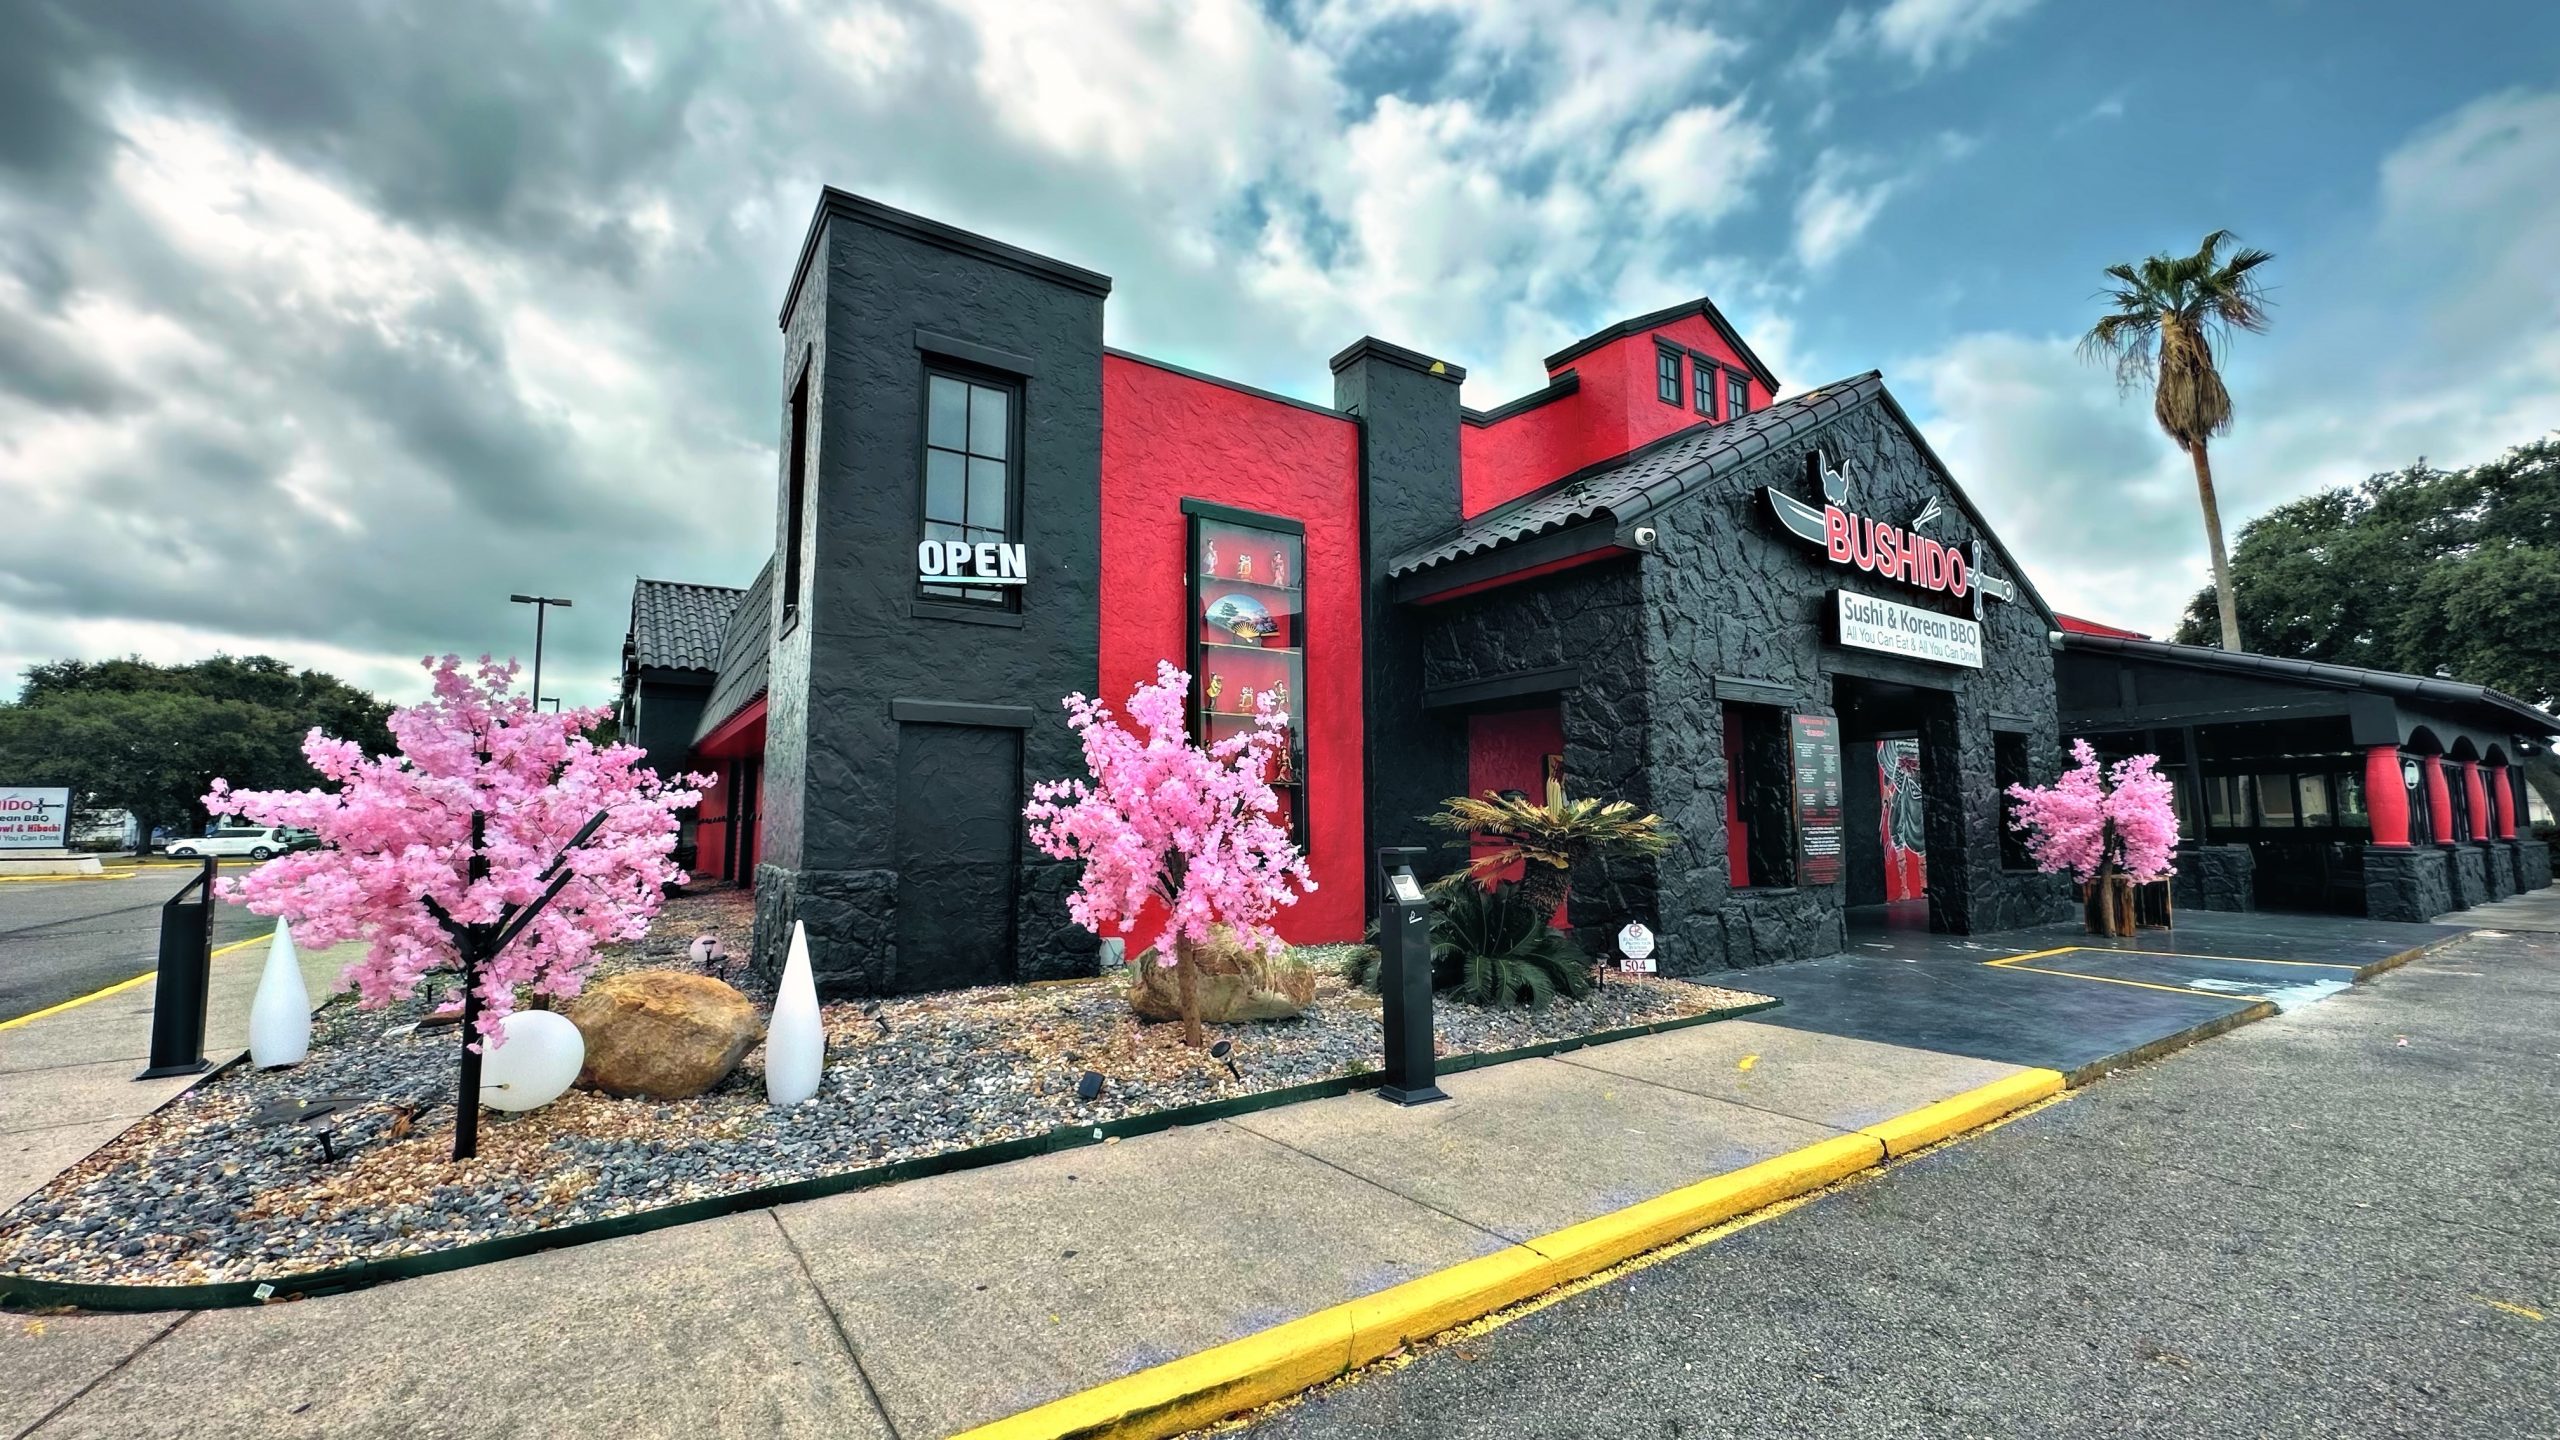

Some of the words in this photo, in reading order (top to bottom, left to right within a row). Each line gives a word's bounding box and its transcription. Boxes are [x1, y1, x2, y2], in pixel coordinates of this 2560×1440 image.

[918, 539, 1027, 578] OPEN
[1824, 503, 1968, 598] BUSHIDO
[1844, 597, 1883, 627] Sushi
[1887, 606, 1897, 630] &
[1900, 609, 1948, 640] Korean
[1949, 621, 1977, 646] BBQ
[1846, 625, 1858, 640] All
[1859, 627, 1876, 643] You
[1877, 631, 1894, 647] Can
[1895, 634, 1910, 650] Eat
[1910, 637, 1917, 651] &
[1918, 640, 1929, 654] All
[1930, 641, 1943, 657] You
[1944, 644, 1959, 659] Can
[1959, 648, 1978, 662] Drink
[17, 824, 24, 832] &
[27, 824, 61, 832] Hibachi
[1625, 960, 1646, 972] 504
